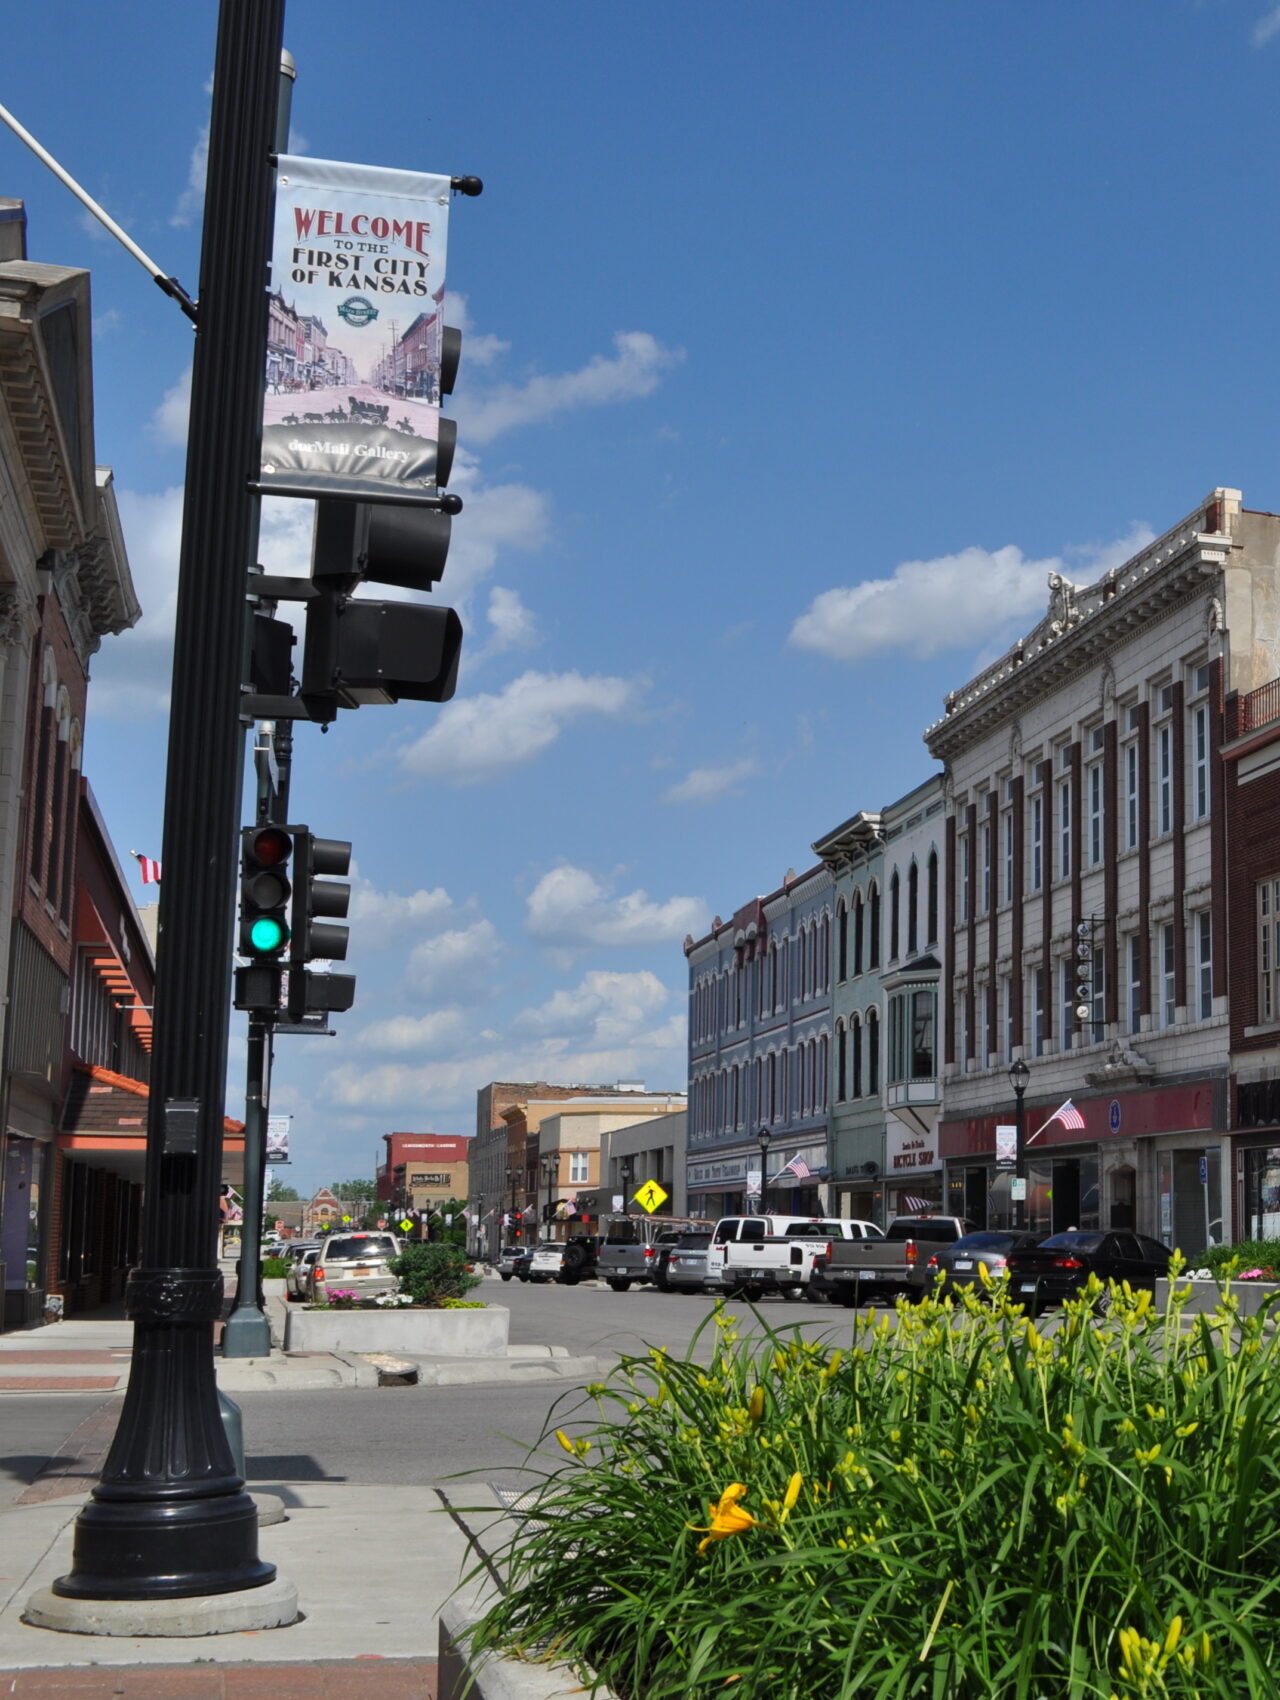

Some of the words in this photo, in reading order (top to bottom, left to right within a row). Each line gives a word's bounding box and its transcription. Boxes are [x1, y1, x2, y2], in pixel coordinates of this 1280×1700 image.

[294, 207, 430, 257] WELCOME
[334, 239, 353, 250] TO
[357, 242, 389, 254] THE
[292, 247, 364, 271] FIRST
[373, 257, 430, 278] CITY
[291, 268, 320, 284] OF
[328, 270, 428, 297] KANSAS
[354, 444, 410, 463] Gallery
[893, 1153, 916, 1169] BICYCLE
[918, 1151, 934, 1165] SHOP
